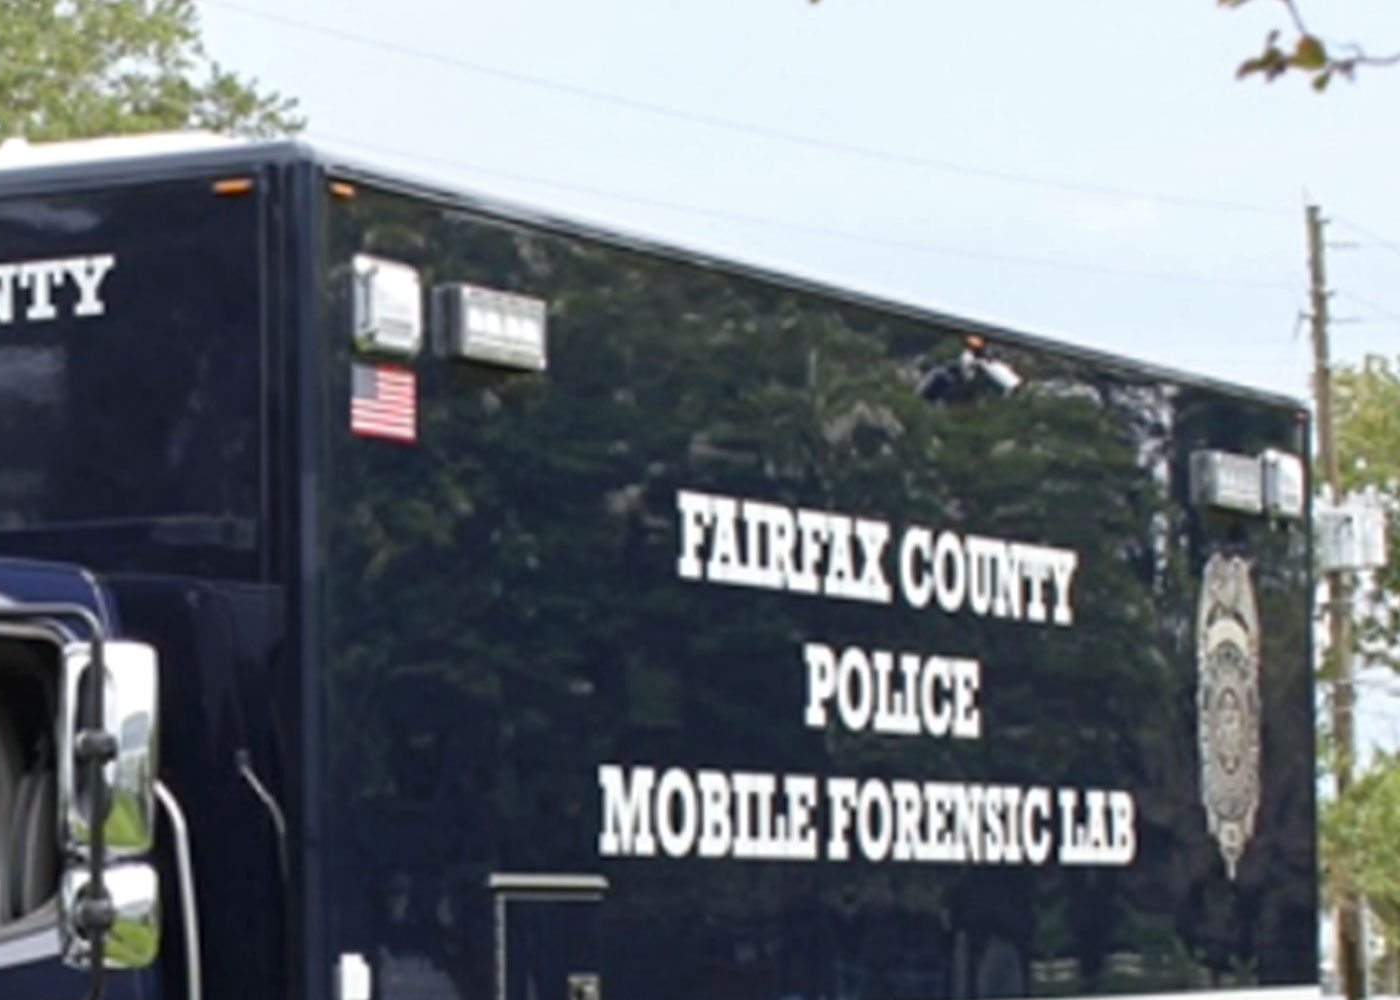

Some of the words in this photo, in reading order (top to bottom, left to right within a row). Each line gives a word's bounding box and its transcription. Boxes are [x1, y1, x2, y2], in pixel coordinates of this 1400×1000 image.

[676, 490, 892, 604] FAIRFAX
[899, 526, 1078, 626] COUNTY
[803, 643, 981, 739] POLICE
[598, 764, 818, 861] MOBILE
[827, 776, 1052, 865] FORENSIC
[1058, 788, 1137, 866] LAB
